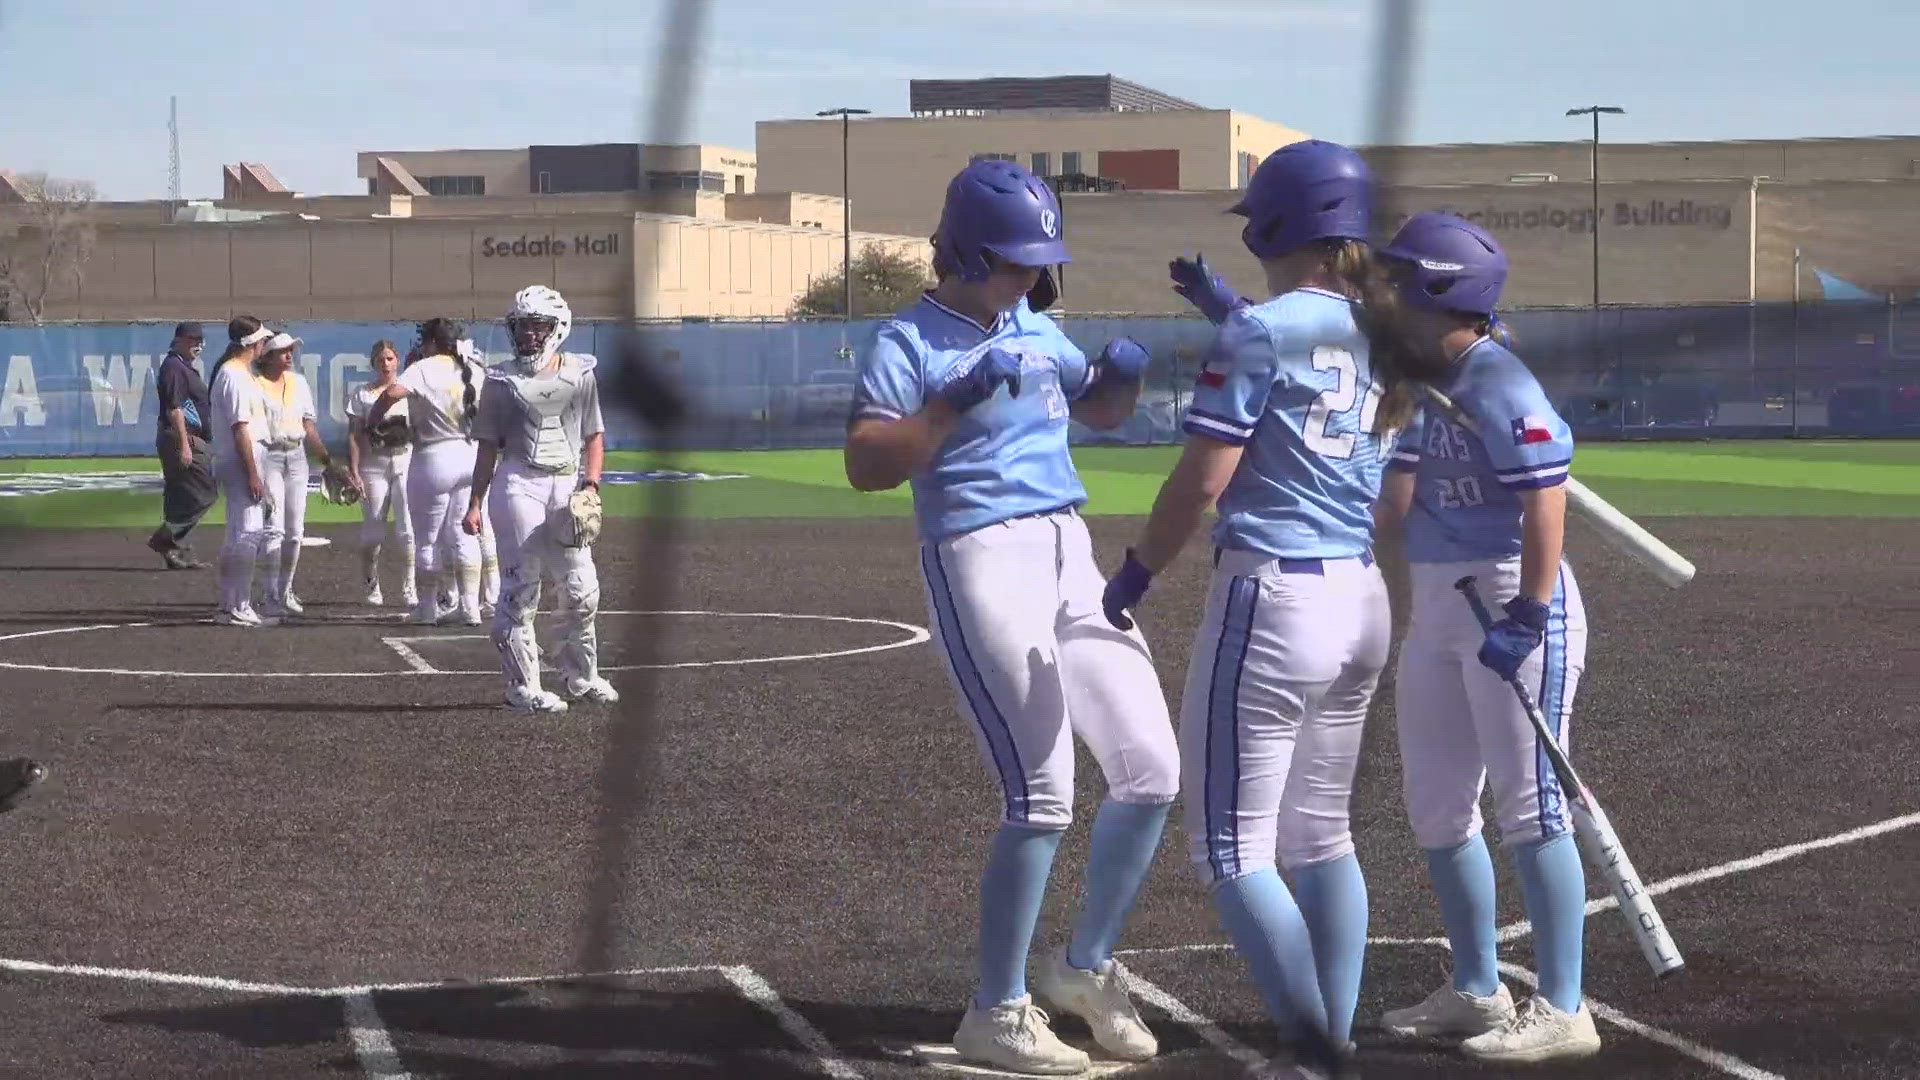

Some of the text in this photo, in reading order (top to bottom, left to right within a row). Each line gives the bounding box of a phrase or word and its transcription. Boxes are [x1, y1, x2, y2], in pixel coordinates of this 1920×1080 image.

[1613, 199, 1732, 230] Building
[481, 232, 619, 258] Sedate Hall
[1433, 474, 1484, 509] 20
